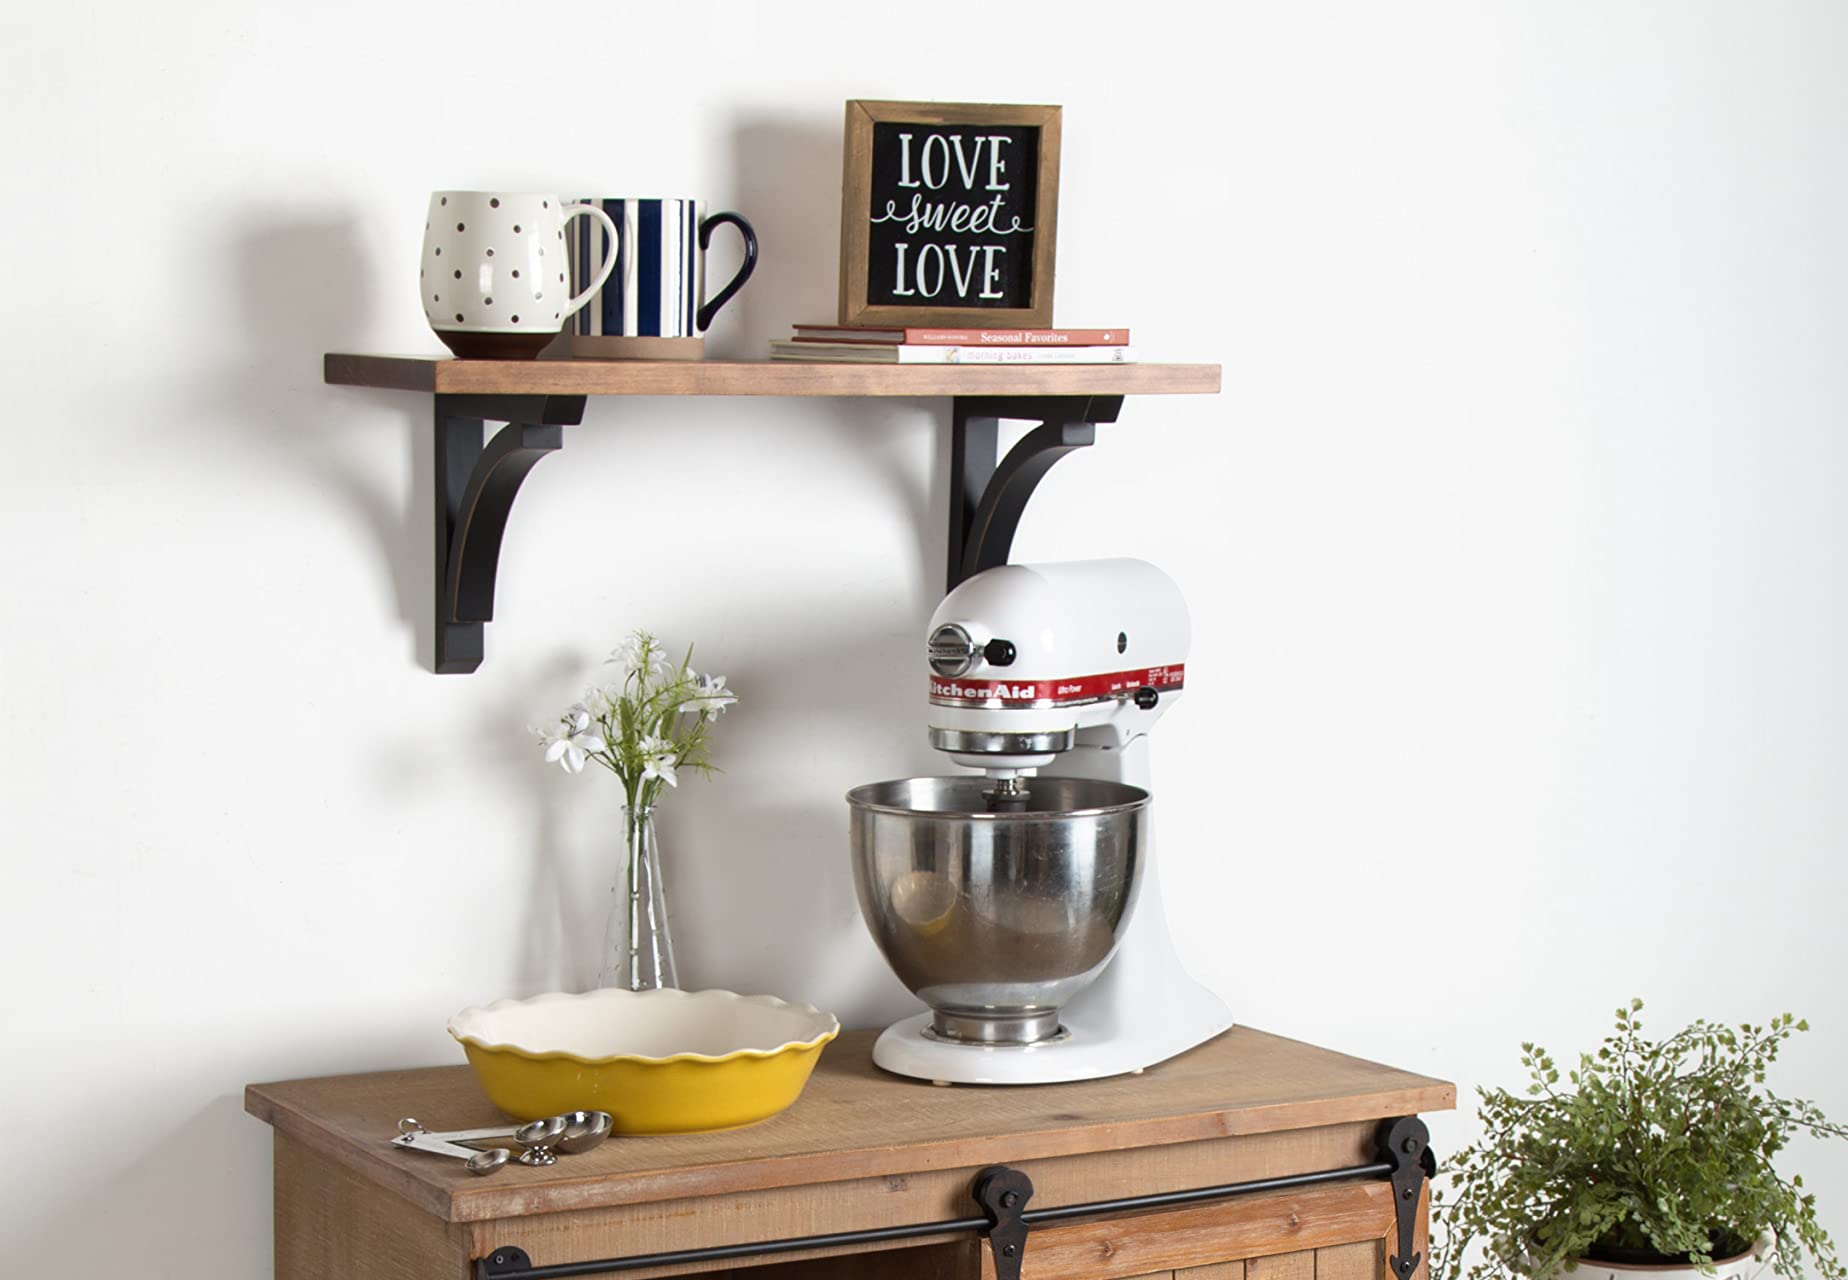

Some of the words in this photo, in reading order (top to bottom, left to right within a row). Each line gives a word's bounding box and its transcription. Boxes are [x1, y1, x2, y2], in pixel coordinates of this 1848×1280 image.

[898, 134, 1012, 190] LOVE
[871, 194, 1034, 234] sweet
[892, 243, 1007, 298] LOVE
[967, 352, 1003, 362] morning
[980, 332, 1022, 342] Seasonal
[1024, 332, 1068, 343] Favorites
